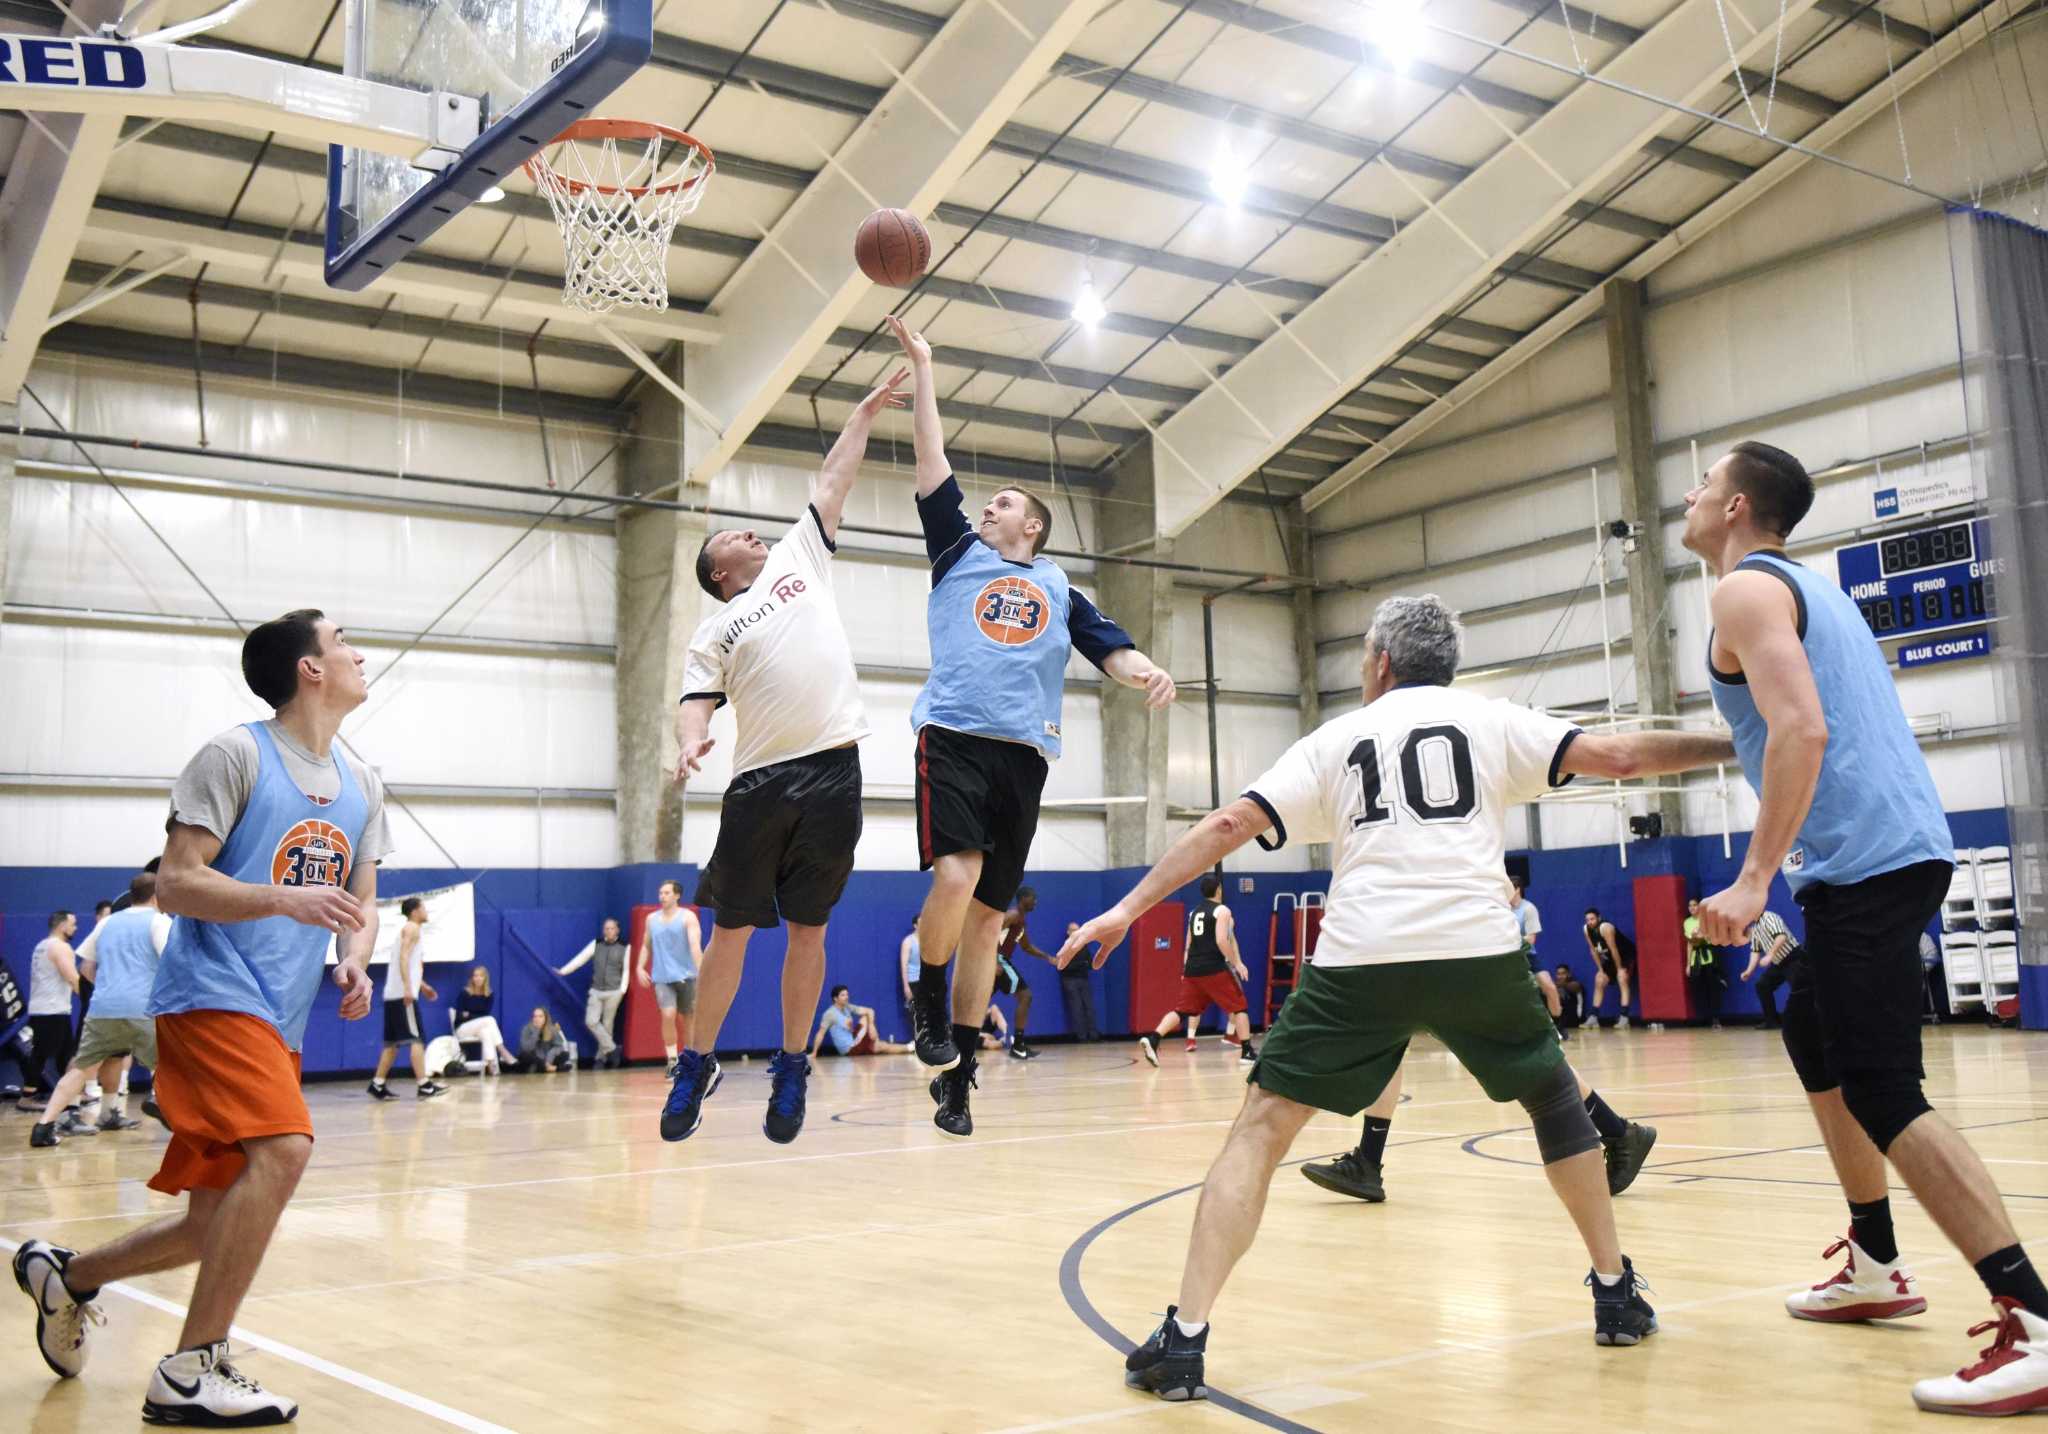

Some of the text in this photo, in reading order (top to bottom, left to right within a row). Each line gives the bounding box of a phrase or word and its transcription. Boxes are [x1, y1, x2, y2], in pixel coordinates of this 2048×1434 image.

[1876, 496, 1897, 510] HSS
[773, 577, 806, 603] Re
[1850, 580, 1888, 600] HOME
[1913, 577, 1946, 593] PERIOD
[983, 593, 1041, 630] 3 ON 3
[1906, 637, 1984, 661] BLUE COURT 1
[1343, 719, 1482, 833] 10
[283, 846, 305, 885] 3
[306, 863, 327, 880] ON
[1193, 911, 1206, 937] 6
